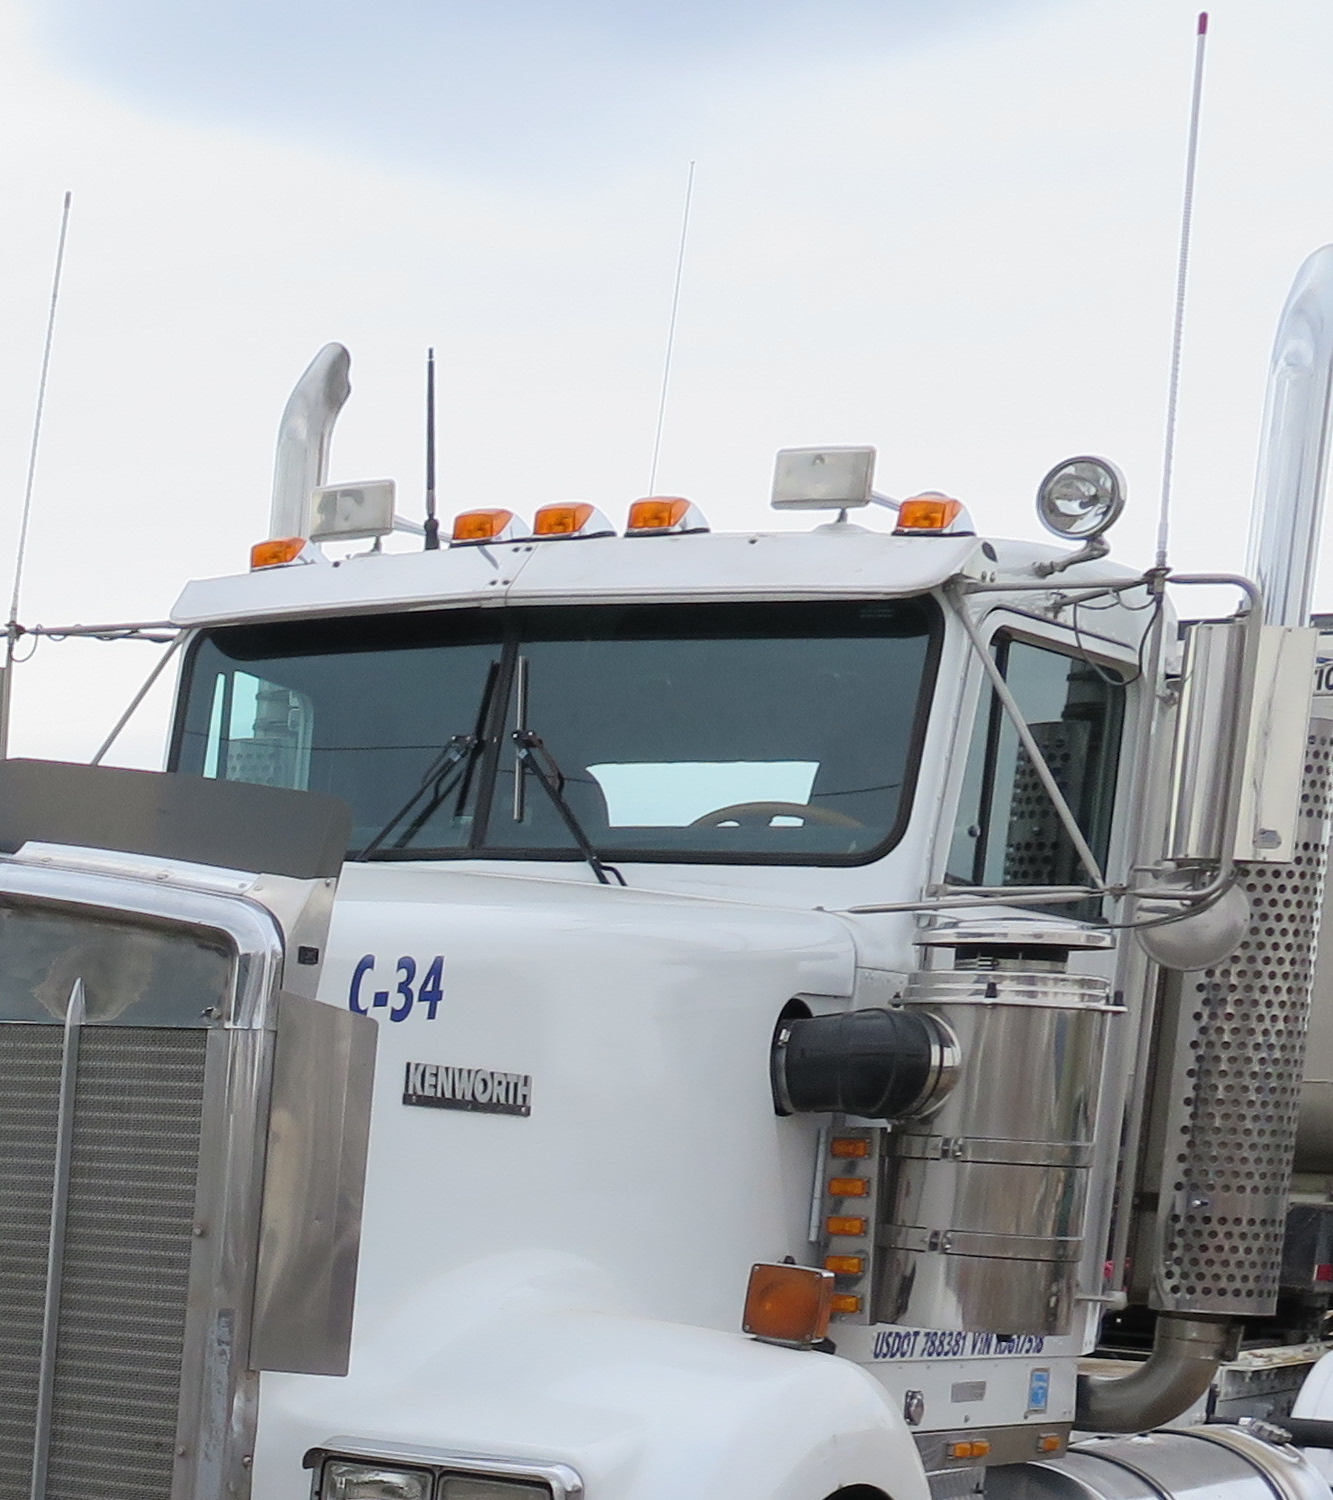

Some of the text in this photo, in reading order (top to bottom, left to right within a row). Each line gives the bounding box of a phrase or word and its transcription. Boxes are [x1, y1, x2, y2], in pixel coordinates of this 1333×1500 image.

[349, 953, 445, 1023] C-34
[406, 1063, 532, 1107] KENWORTH
[873, 1331, 920, 1359] USDOT
[920, 1331, 967, 1357] 788381
